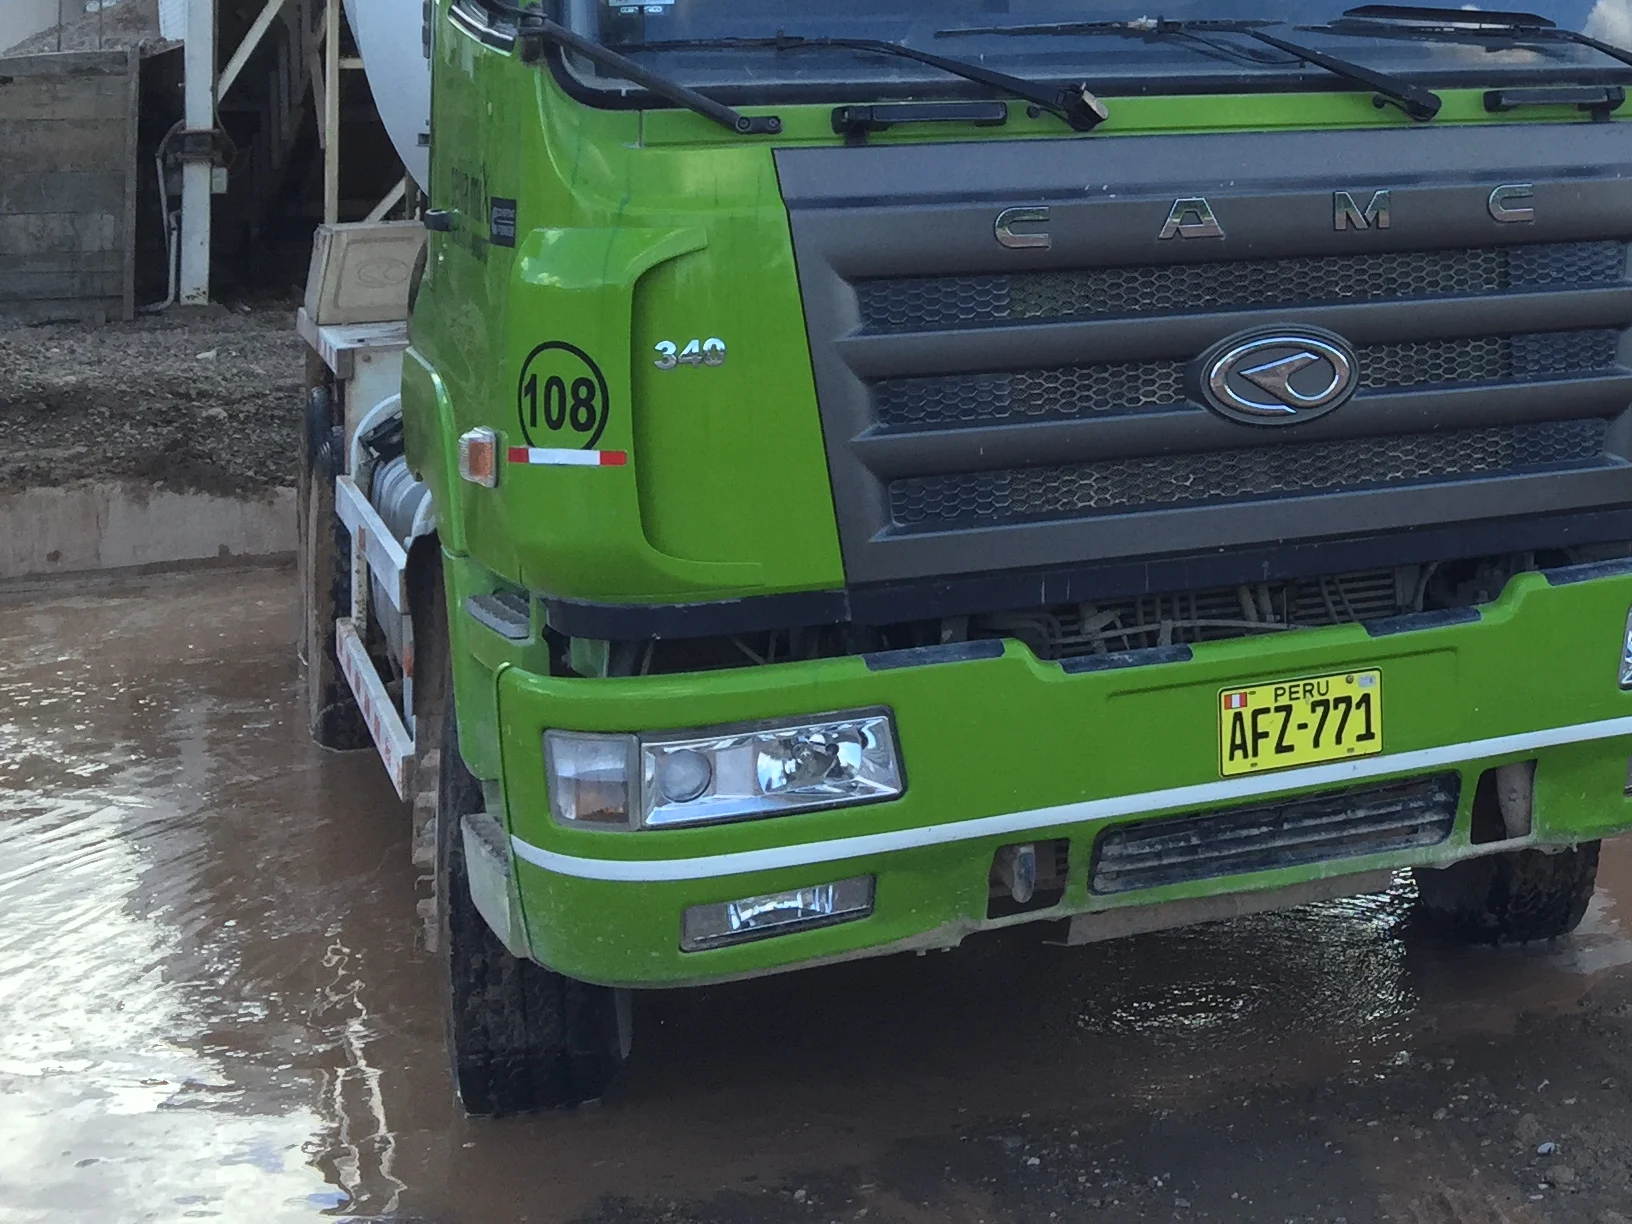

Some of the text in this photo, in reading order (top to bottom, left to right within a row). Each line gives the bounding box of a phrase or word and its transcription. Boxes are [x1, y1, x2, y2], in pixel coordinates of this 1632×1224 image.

[653, 337, 726, 370] 340
[524, 373, 597, 432] 108
[1274, 680, 1329, 703] PERU
[1229, 693, 1375, 761] AFZ-771
